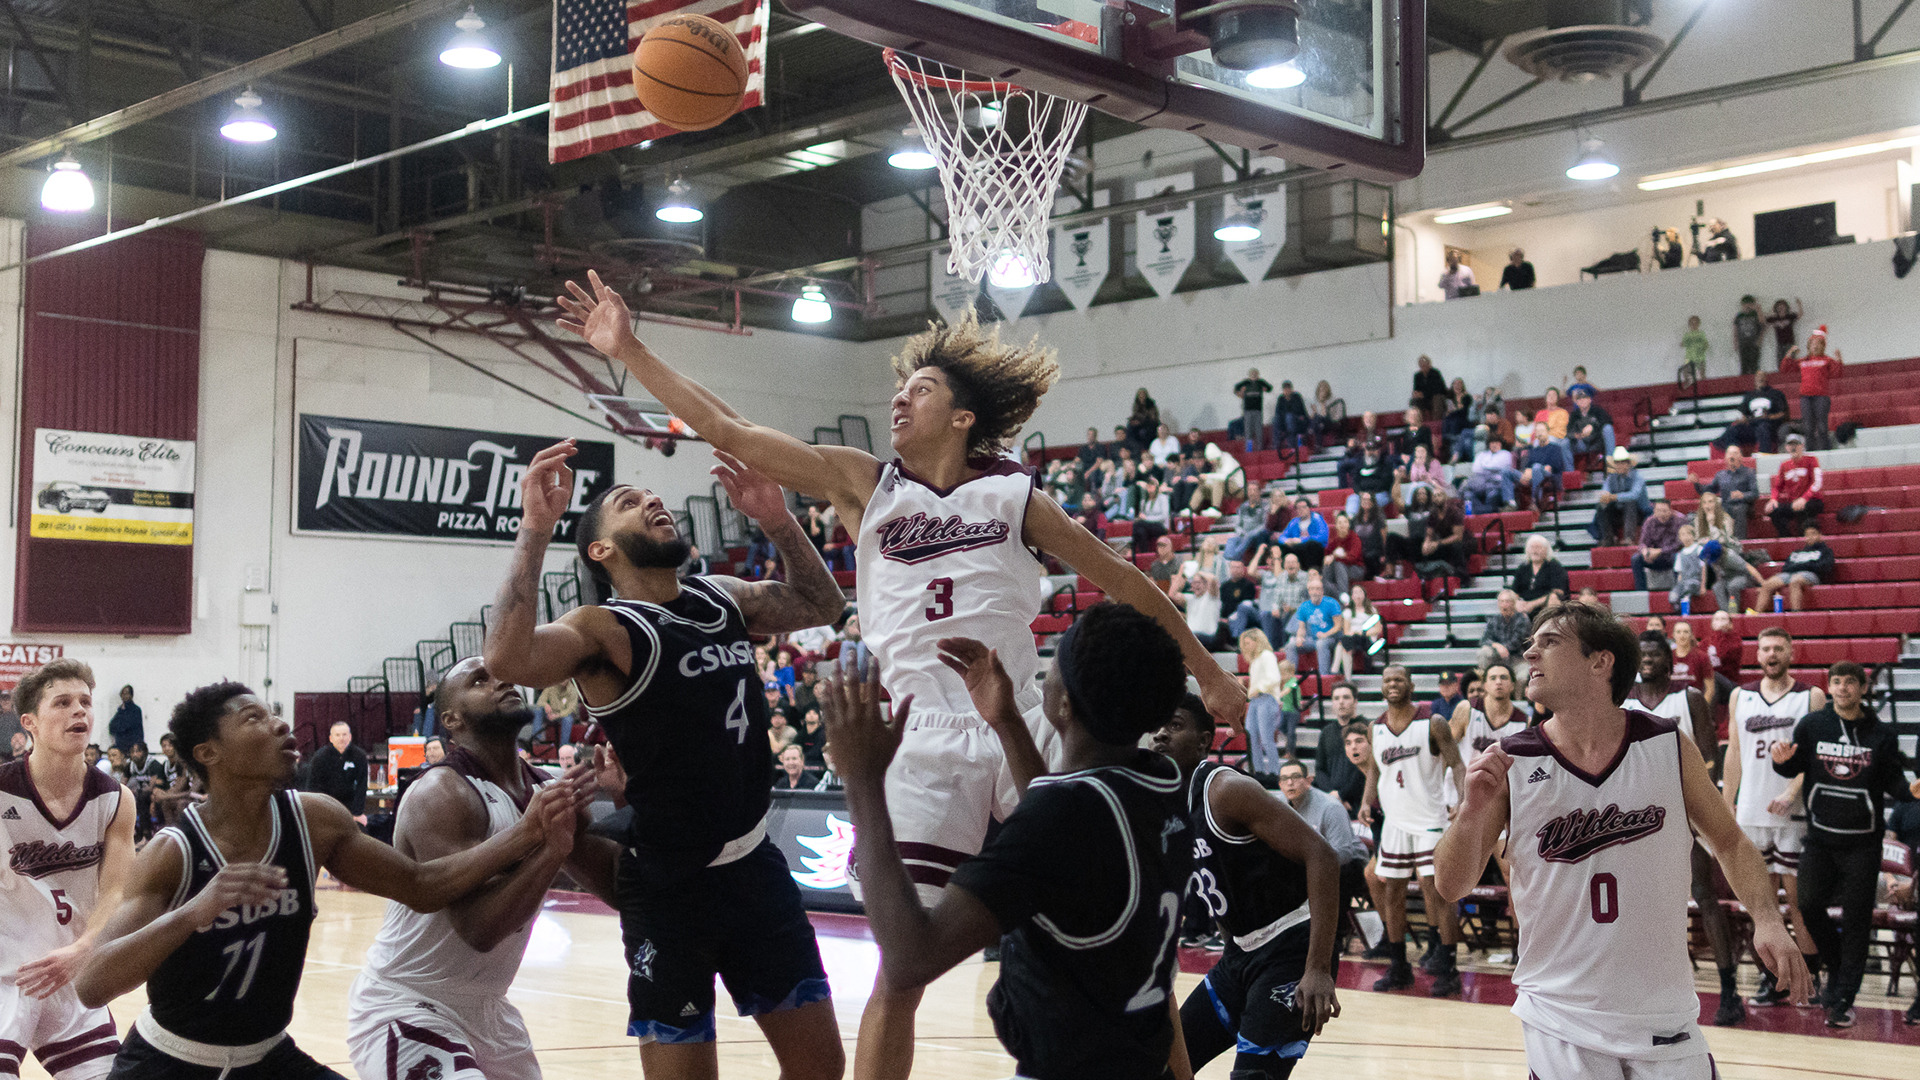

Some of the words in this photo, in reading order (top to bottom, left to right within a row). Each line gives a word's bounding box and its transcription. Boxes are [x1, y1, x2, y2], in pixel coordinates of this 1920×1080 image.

[45, 432, 134, 457] Concours
[138, 440, 181, 463] Elite
[467, 440, 601, 518] TAE
[437, 511, 487, 531] PIZZA
[877, 512, 1009, 556] Wildcats
[926, 577, 953, 622] 3
[725, 678, 749, 744] 4
[1816, 741, 1843, 756] CHICO
[1397, 770, 1405, 788] 4
[1536, 803, 1666, 858] Wildcats
[50, 889, 72, 925] 5
[196, 888, 300, 933] SUSB
[1590, 872, 1619, 924] 0
[204, 931, 267, 1000] 11
